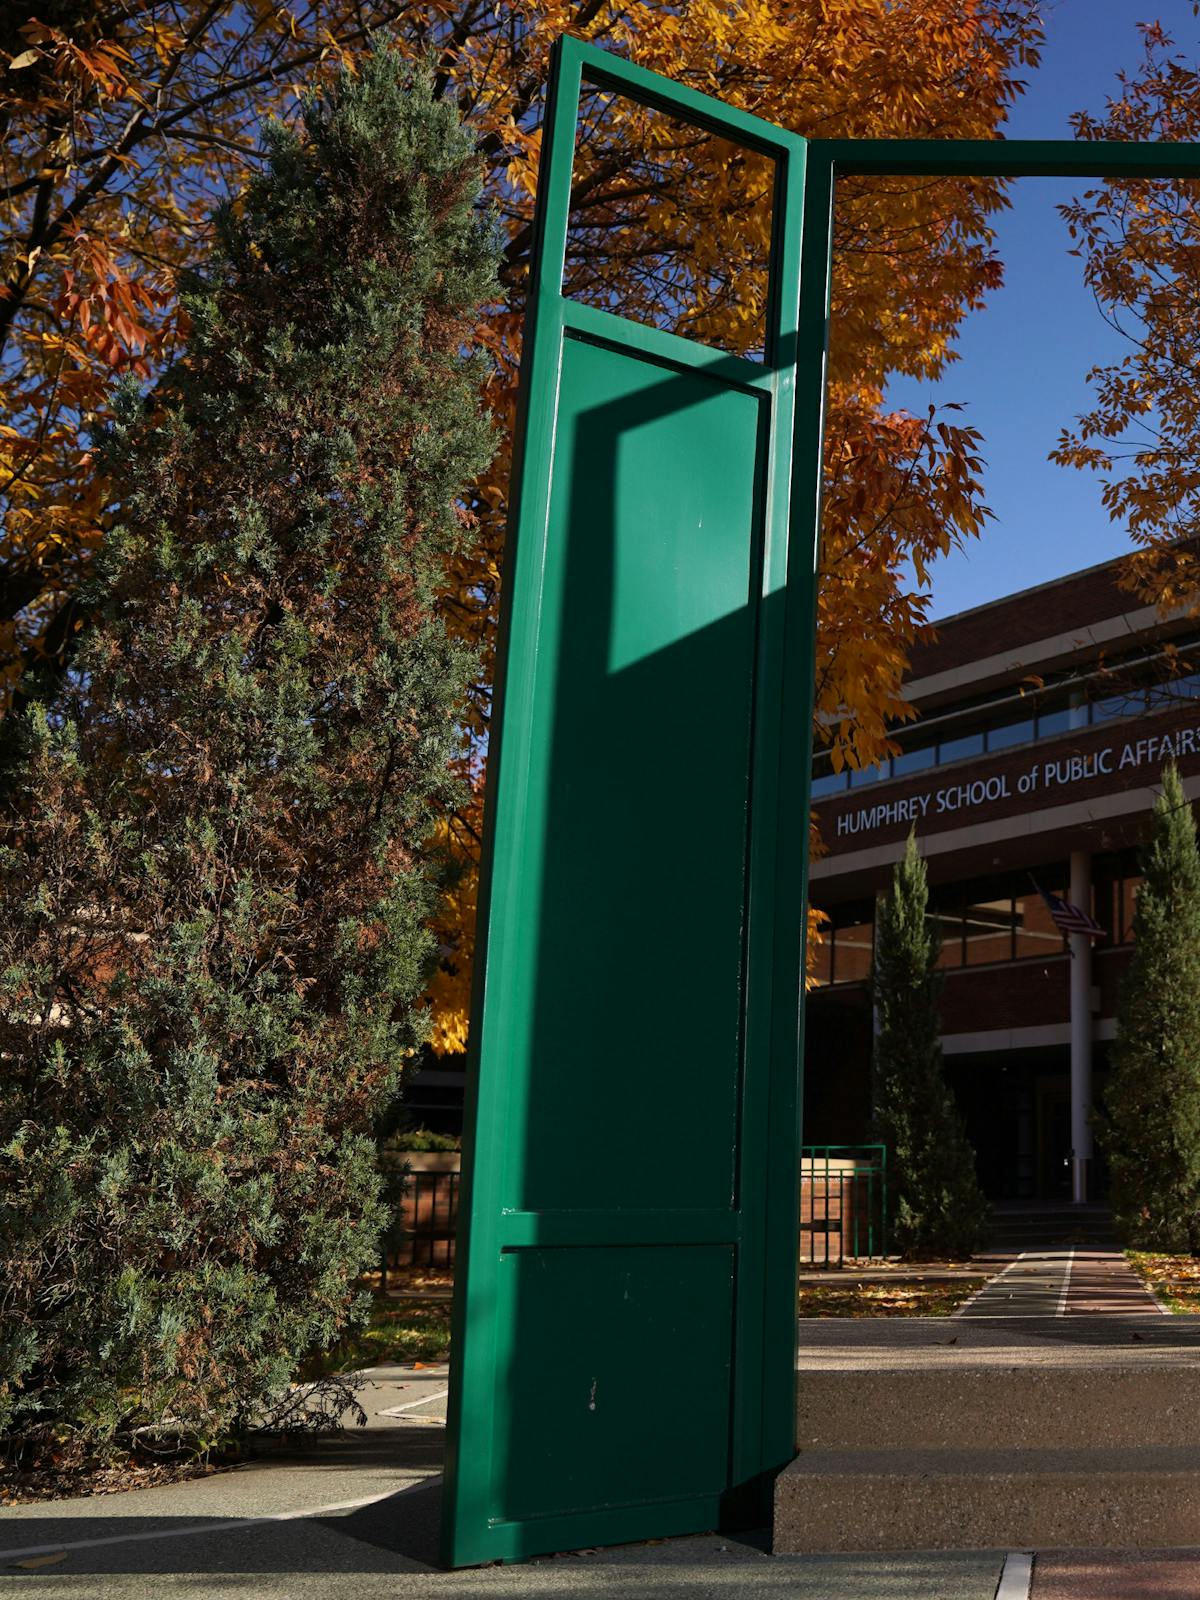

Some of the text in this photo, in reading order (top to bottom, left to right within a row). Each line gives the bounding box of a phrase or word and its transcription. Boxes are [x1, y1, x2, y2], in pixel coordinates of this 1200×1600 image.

[837, 795, 930, 836] HUMPHREY
[935, 776, 1011, 813] SCHOOL
[1017, 764, 1039, 793] of
[1044, 748, 1112, 788] PUBLIC
